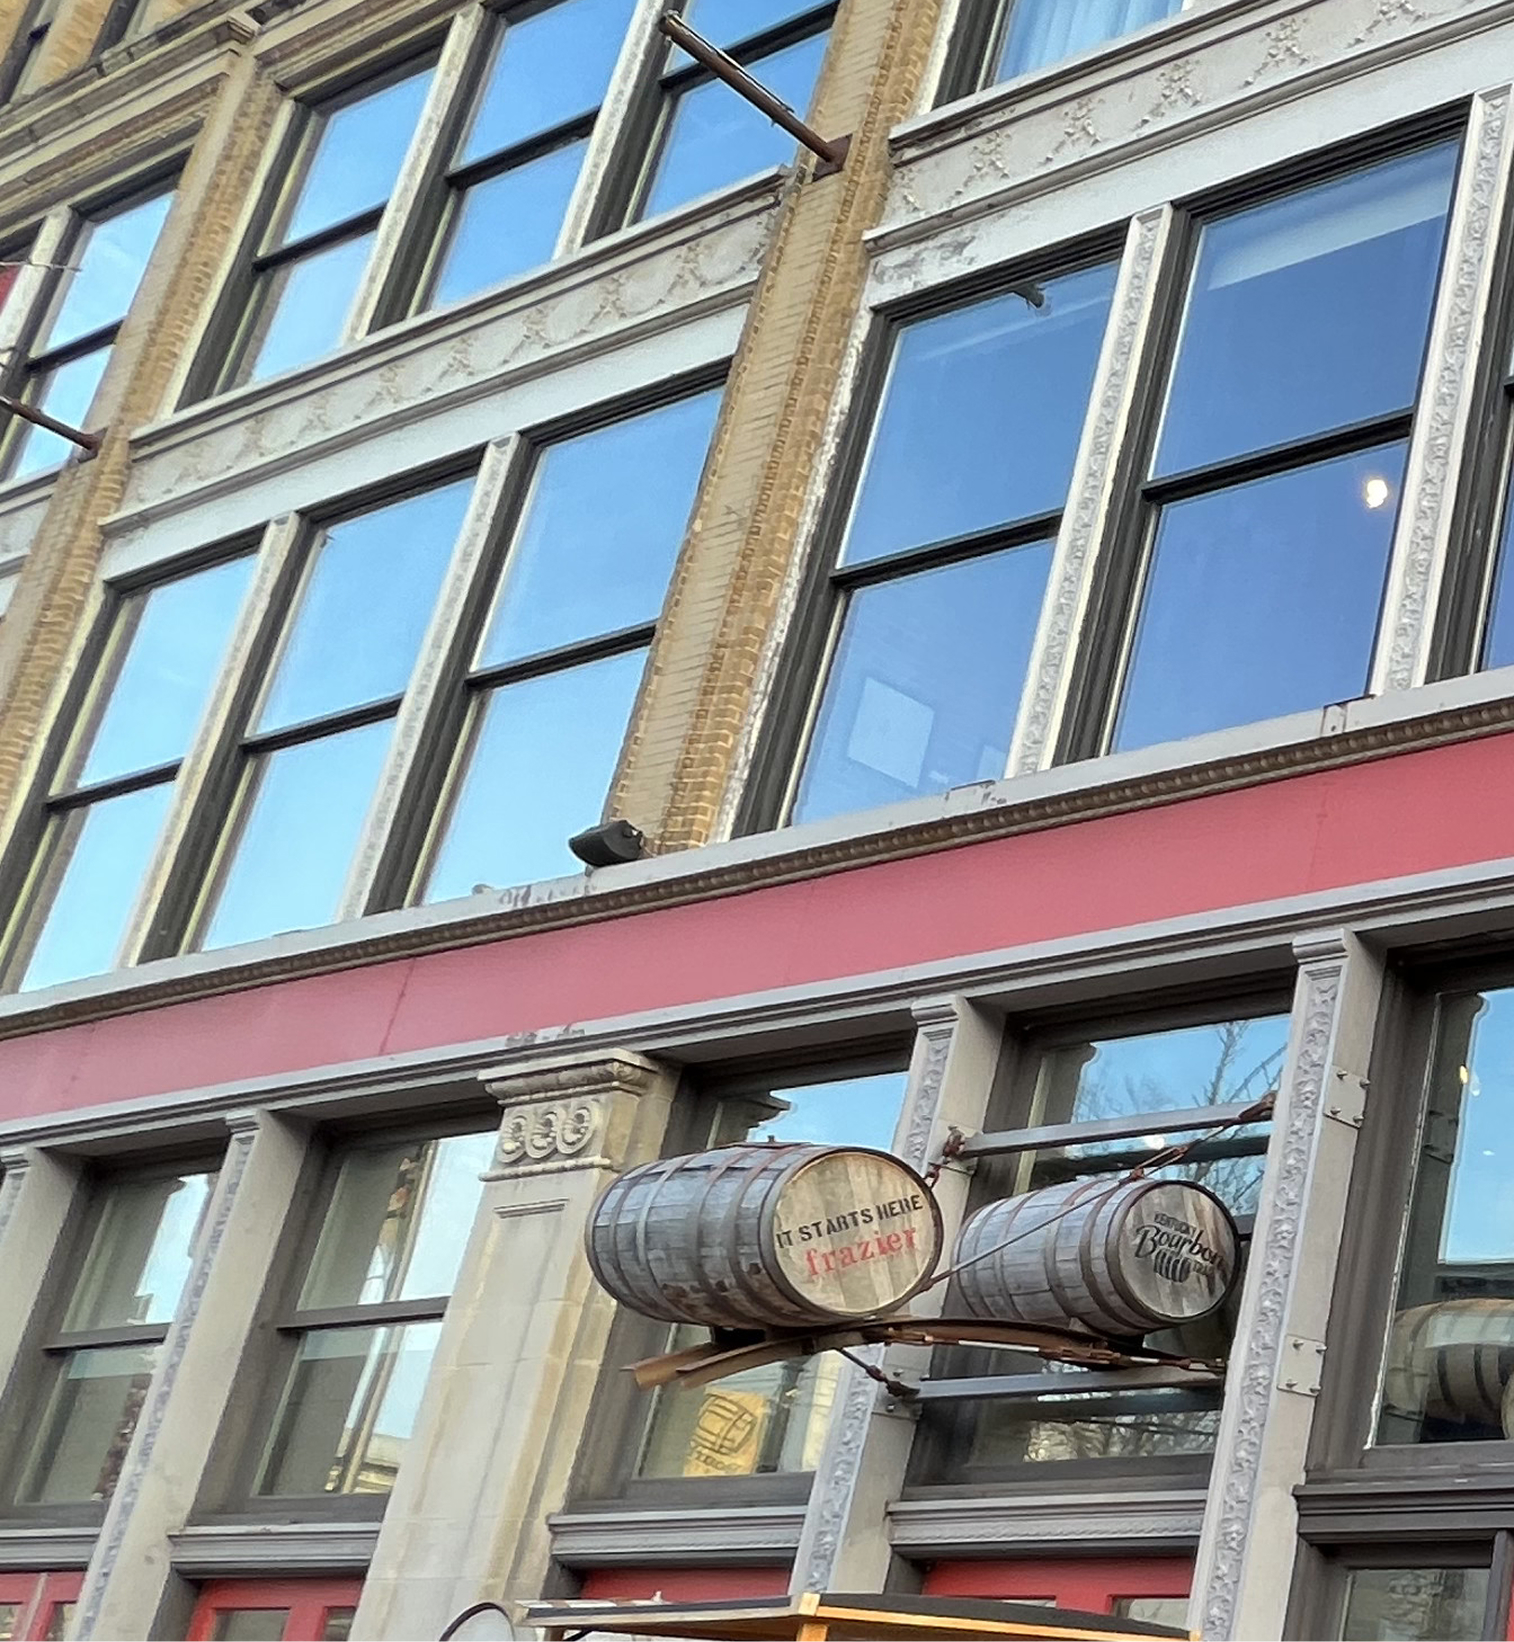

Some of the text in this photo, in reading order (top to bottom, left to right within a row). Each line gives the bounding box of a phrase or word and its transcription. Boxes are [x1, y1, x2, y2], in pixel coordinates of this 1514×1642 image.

[776, 1194, 924, 1249] IT STARTS HERE
[805, 1227, 917, 1276] frazier
